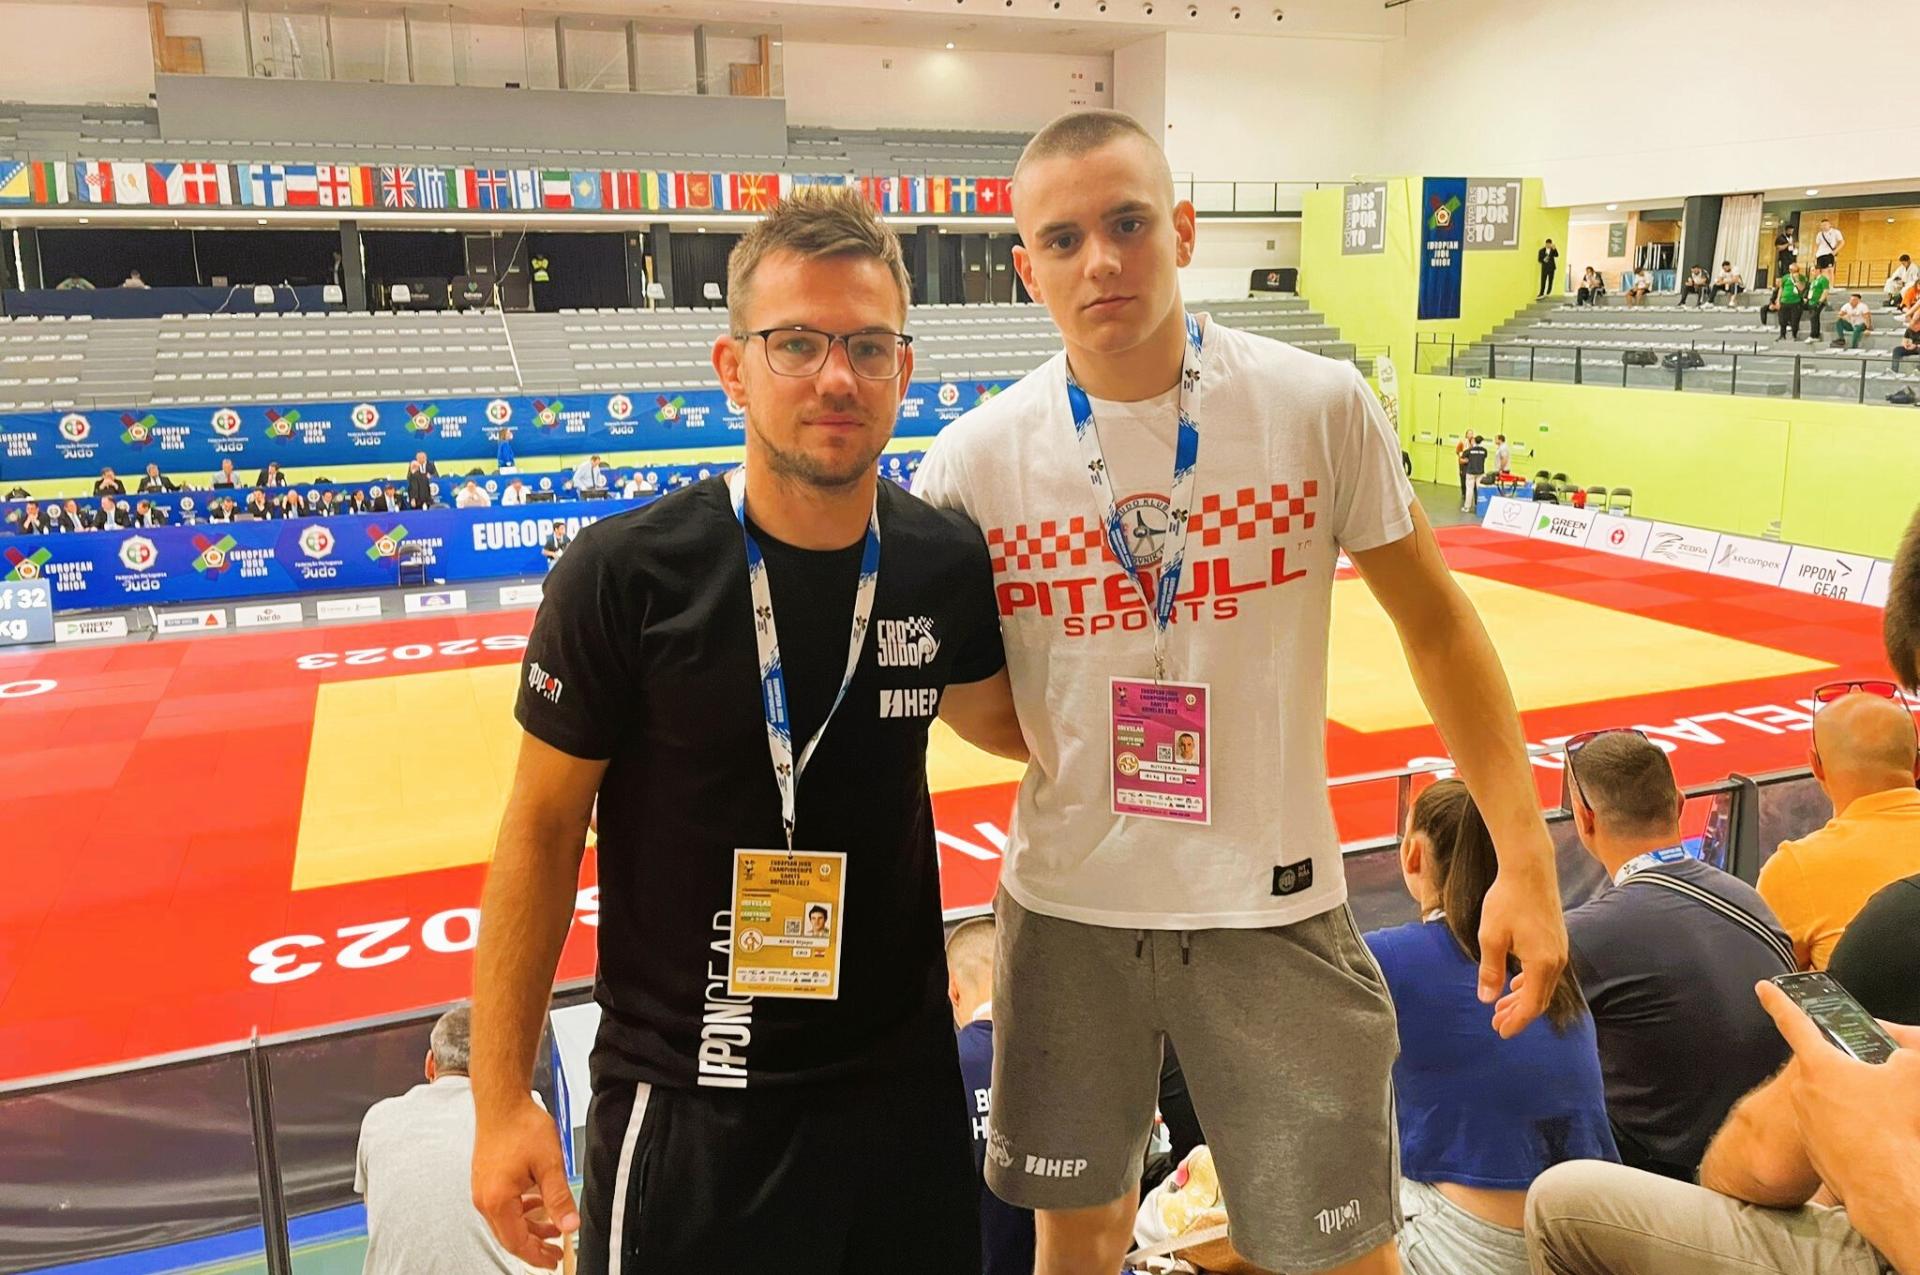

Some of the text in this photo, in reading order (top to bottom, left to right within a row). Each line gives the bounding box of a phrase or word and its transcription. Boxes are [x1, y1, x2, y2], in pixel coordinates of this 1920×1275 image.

[1352, 192, 1375, 211] DES
[1477, 186, 1507, 204] DES
[1351, 210, 1377, 229] POR
[1476, 205, 1509, 223] POR
[1351, 229, 1366, 247] TO
[1476, 224, 1495, 242] TO
[295, 421, 331, 431] EUROPEAN
[433, 416, 467, 425] EUROPEAN
[152, 427, 190, 436] EUROPEAN
[161, 441, 185, 451] UNION
[1119, 499, 1139, 514] UDO
[1552, 517, 1587, 530] GREEN
[1550, 526, 1577, 538] HILL
[230, 548, 275, 561] EUROPEAN
[1678, 543, 1709, 555] ZEBRA
[45, 561, 93, 574] EUROPEAN
[242, 558, 264, 568] JUDO
[58, 571, 82, 582] JUDO
[240, 567, 268, 577] UNION
[1799, 564, 1837, 582] IPPON
[57, 580, 86, 592] UNION
[1813, 582, 1848, 600] GEAR
[17, 587, 47, 609] 32
[1063, 597, 1239, 636] SPORTS
[877, 619, 906, 643] CRO
[878, 642, 919, 667] JUDO
[904, 688, 938, 717] HEP
[1046, 1159, 1088, 1177] HEP
